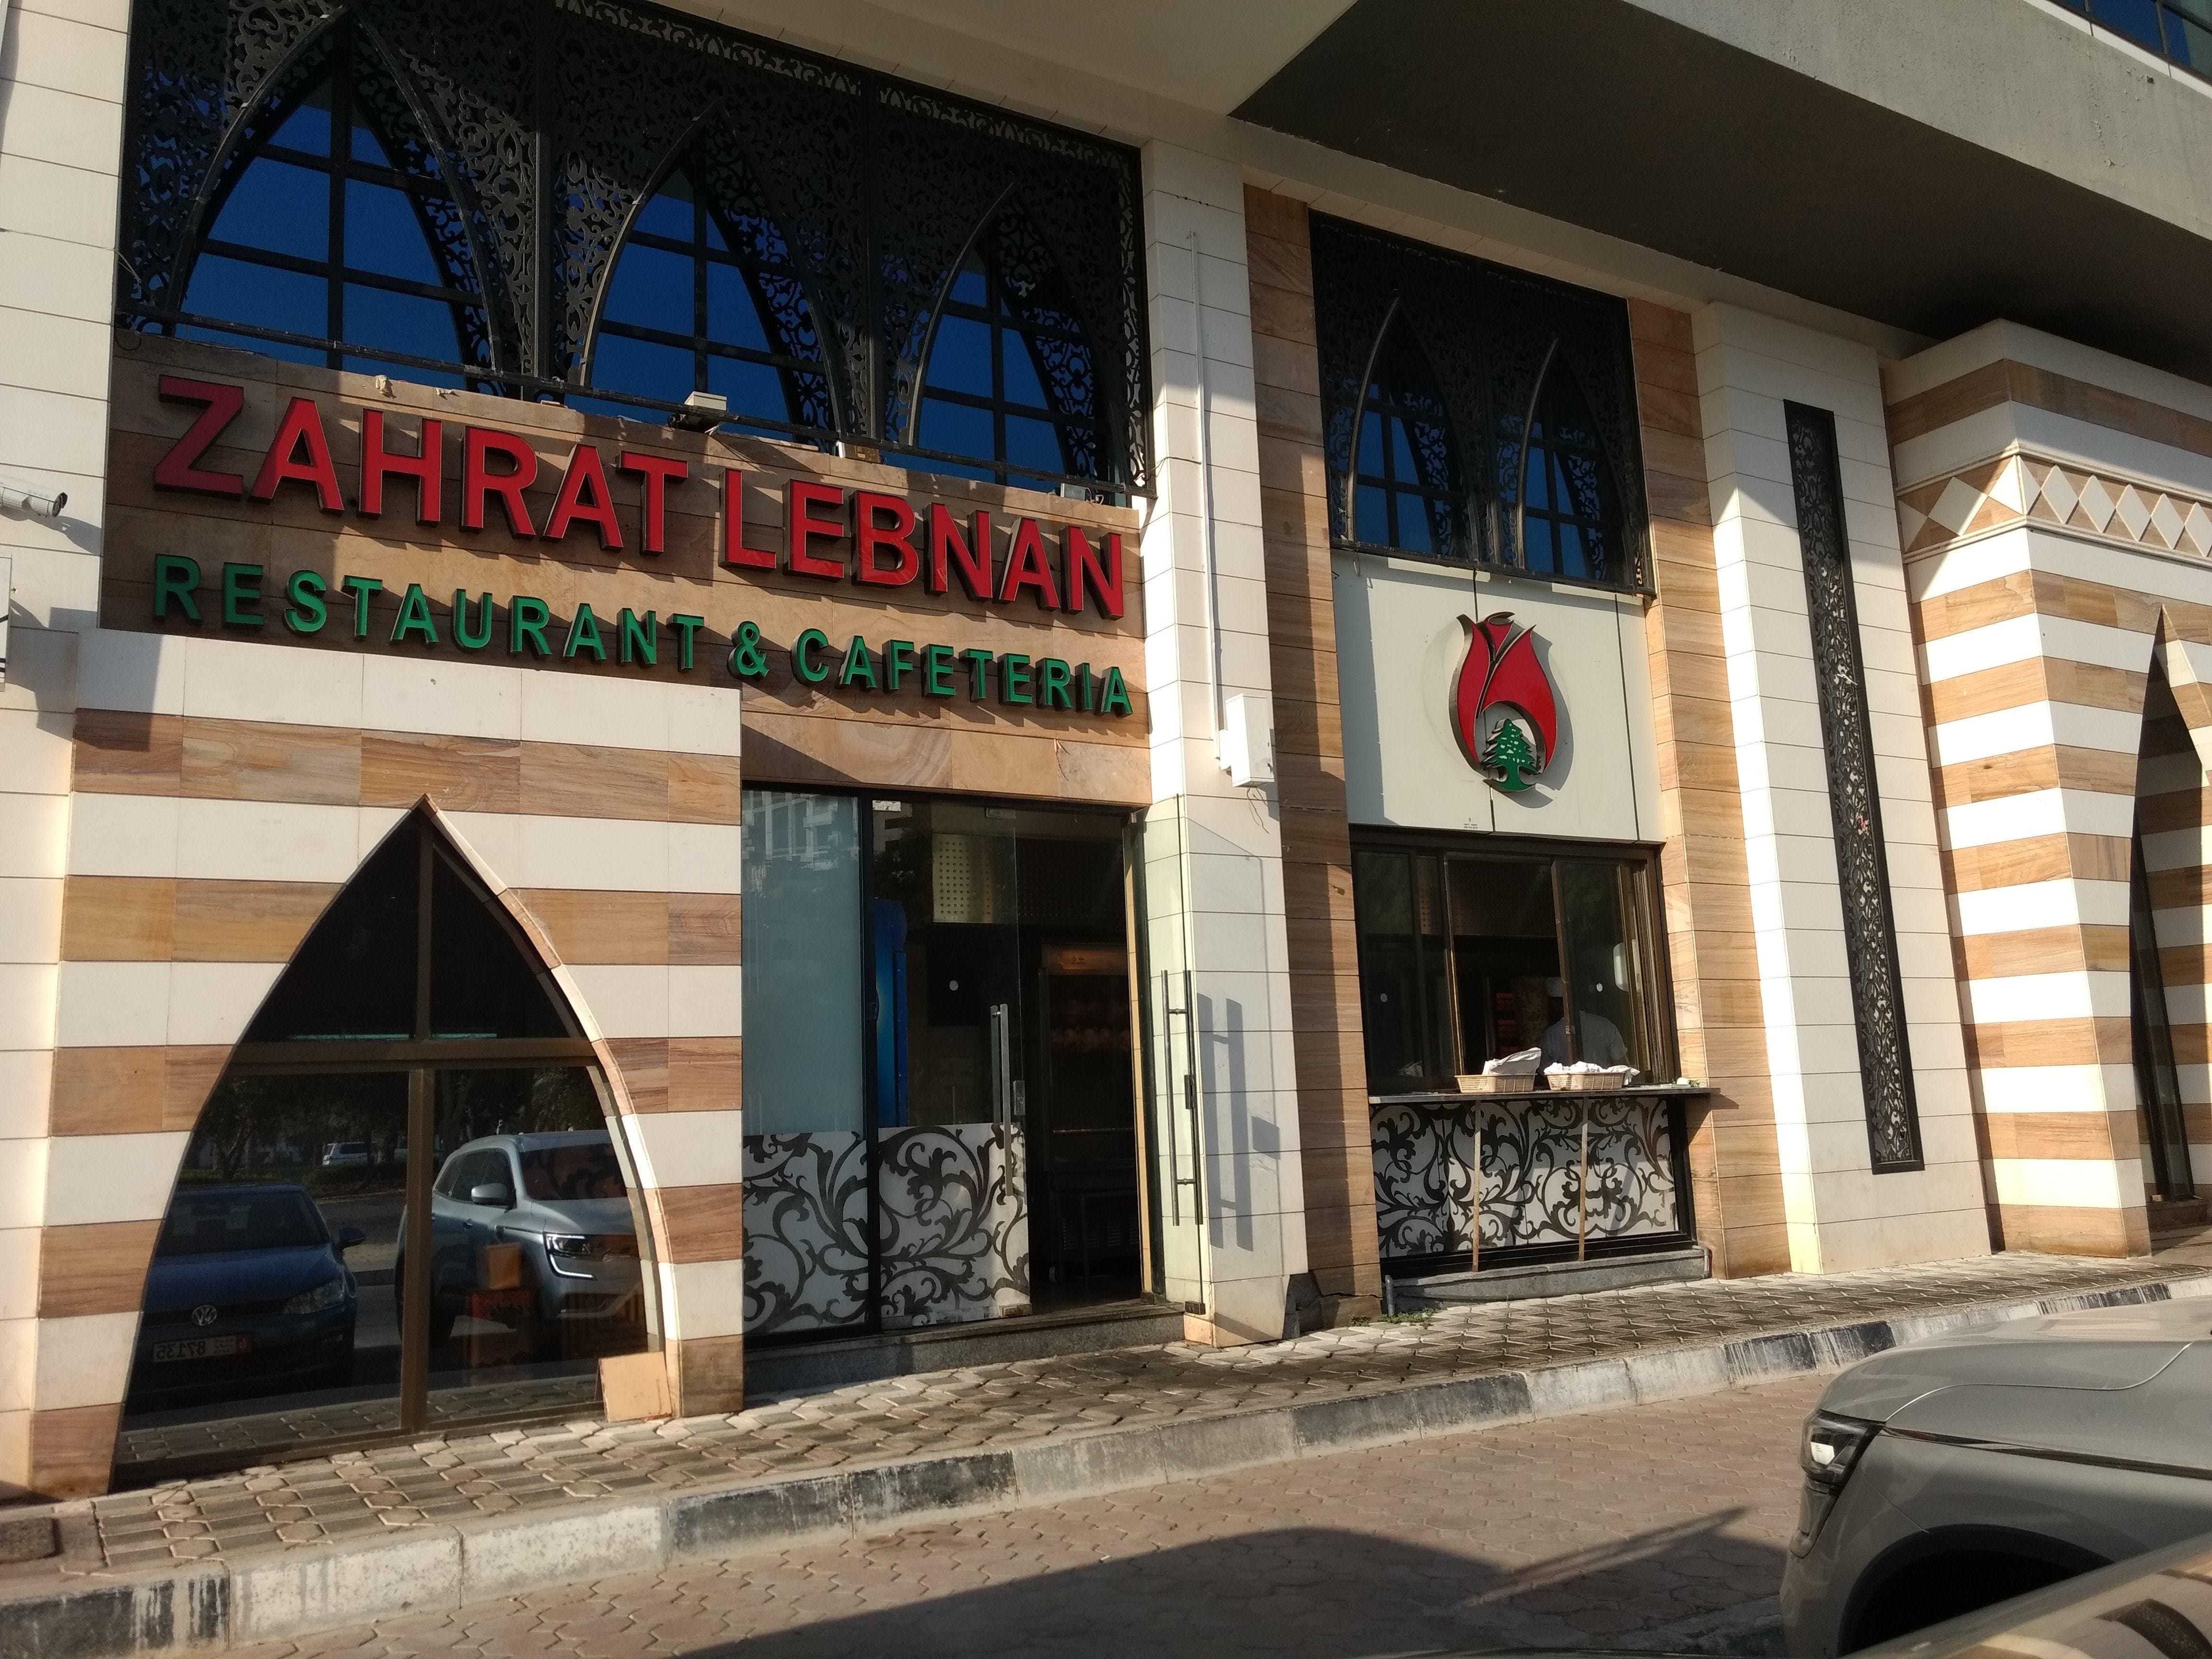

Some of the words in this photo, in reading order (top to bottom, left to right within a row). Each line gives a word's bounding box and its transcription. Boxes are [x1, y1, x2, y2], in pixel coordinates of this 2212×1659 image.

[153, 374, 689, 557] ZAHRAT
[719, 468, 1124, 620] LEBNAN
[154, 553, 705, 672] RESTAURANT
[727, 620, 769, 682] &
[790, 627, 1133, 718] CAFETERIA
